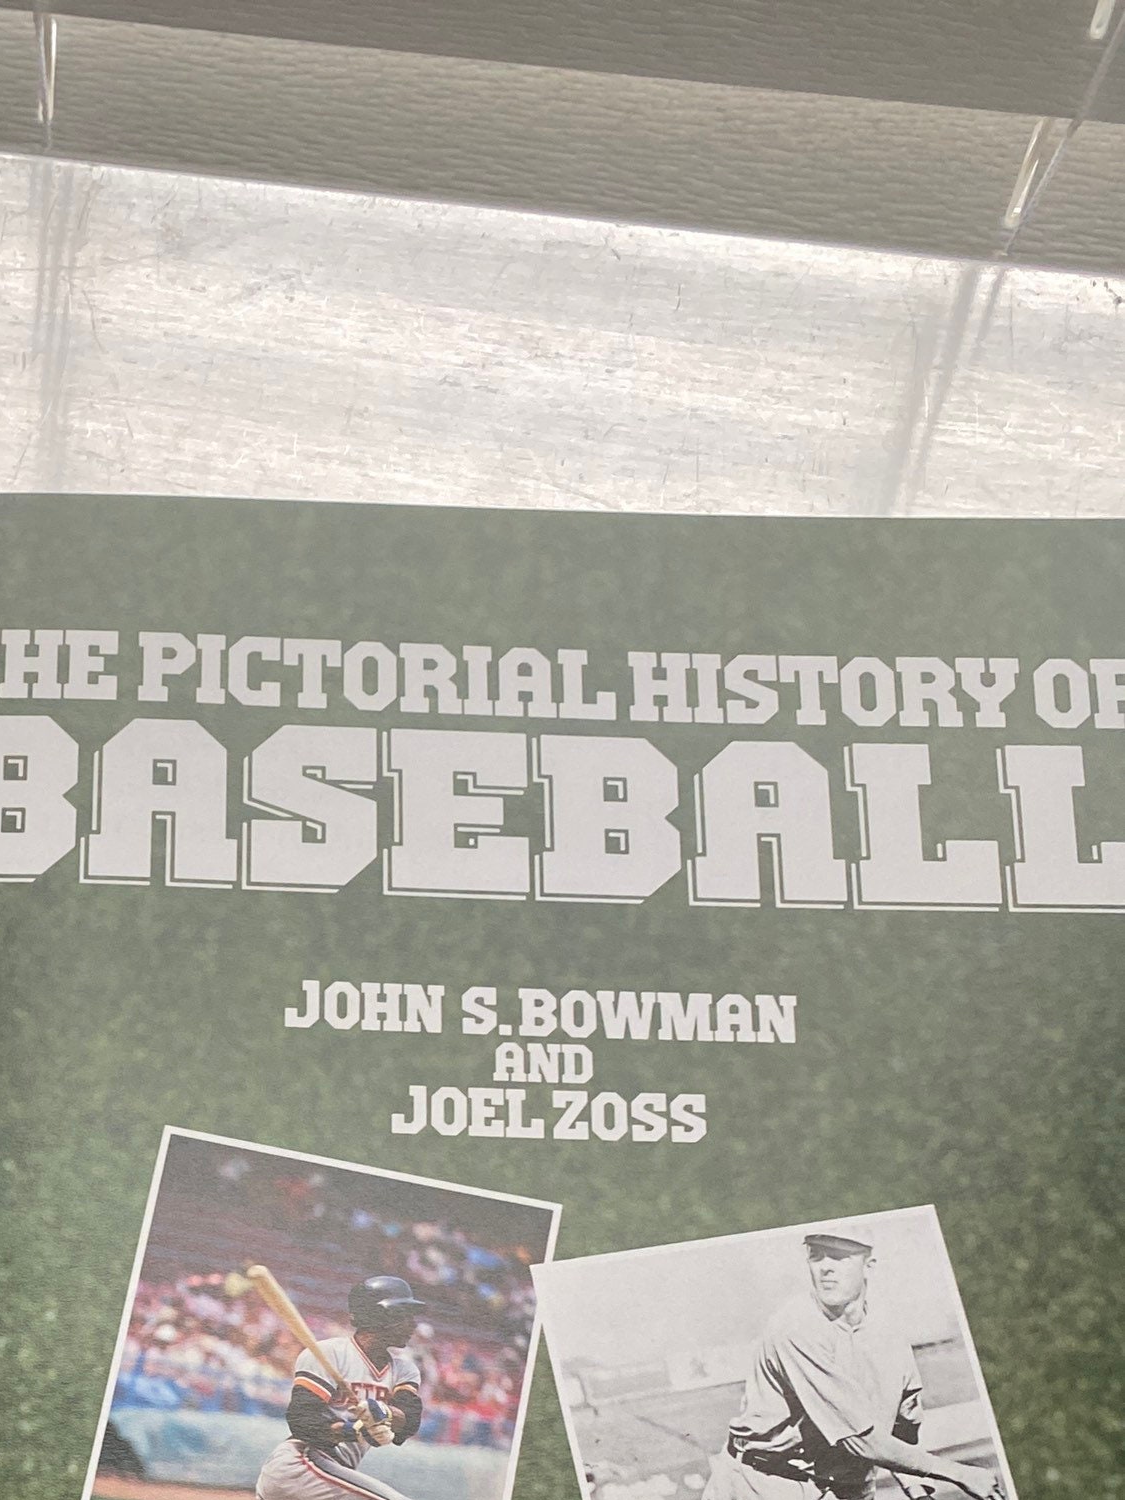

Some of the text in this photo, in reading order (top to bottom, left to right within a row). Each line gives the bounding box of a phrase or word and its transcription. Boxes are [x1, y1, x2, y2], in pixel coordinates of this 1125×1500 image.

[137, 631, 617, 721] PICTORIAL
[627, 651, 1020, 728] HISTORY
[284, 979, 446, 1034] JOHN
[492, 1041, 594, 1084] AND
[390, 1084, 708, 1143] JOEL ZOSS
